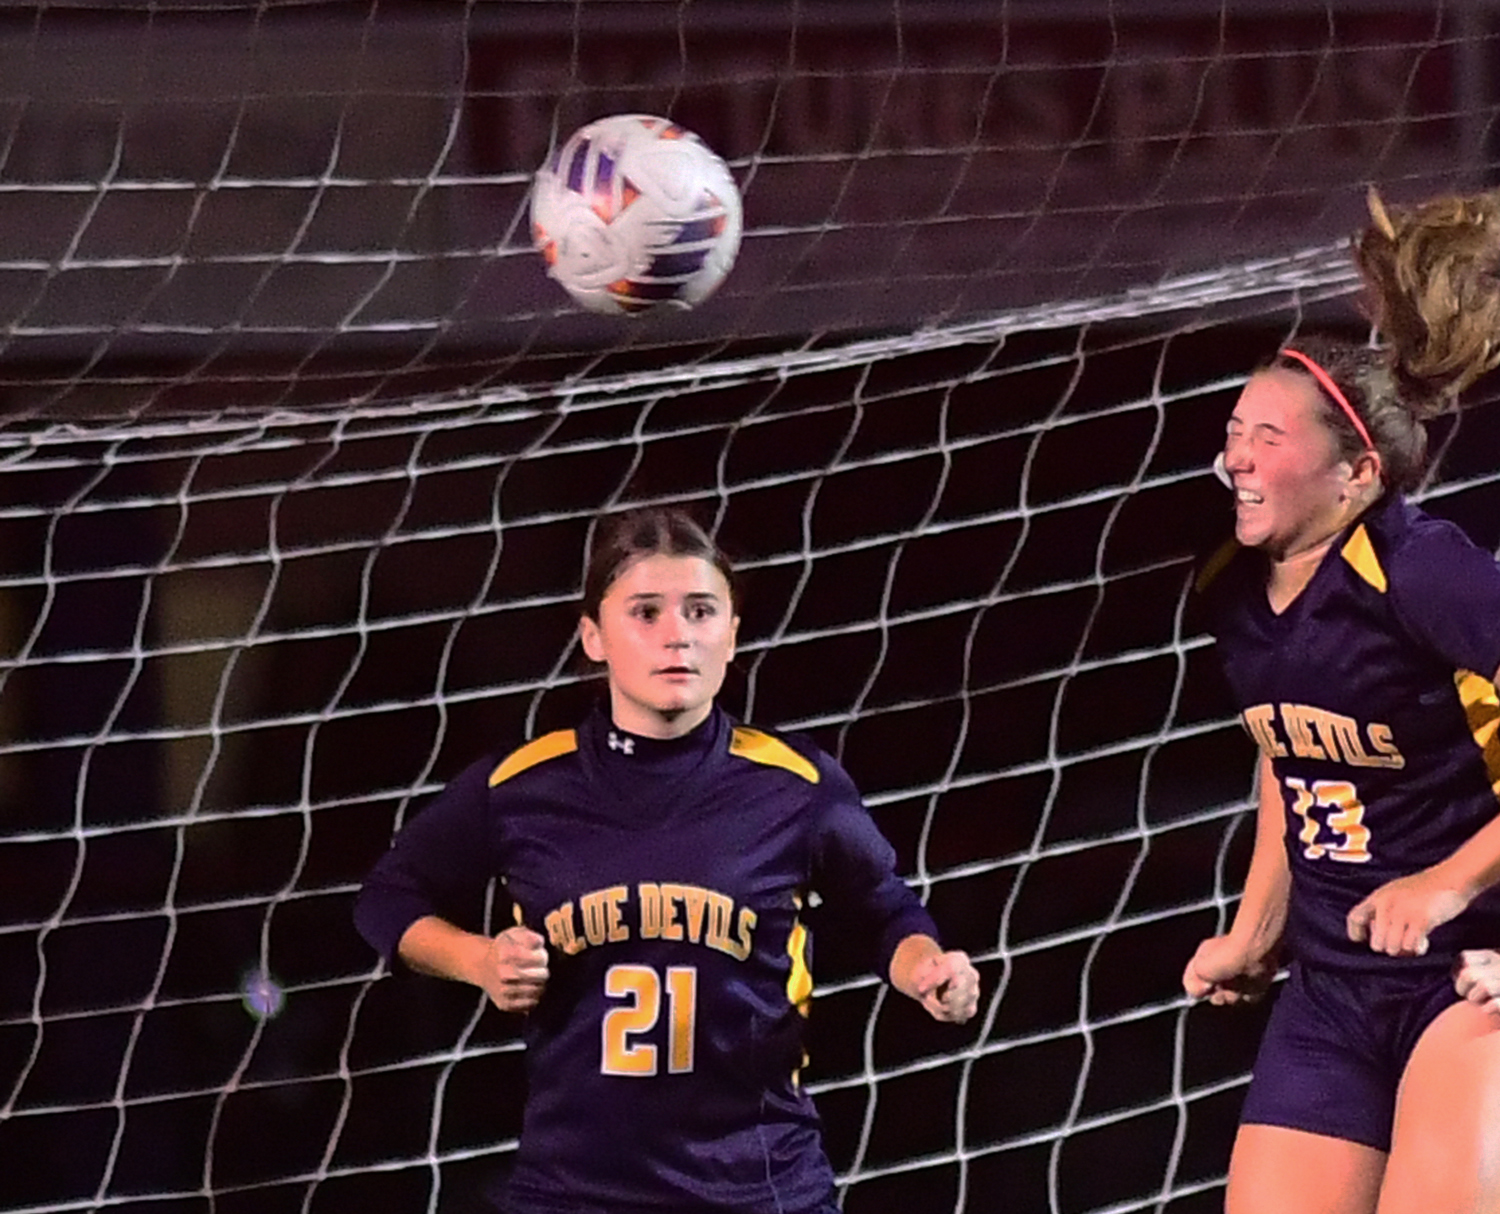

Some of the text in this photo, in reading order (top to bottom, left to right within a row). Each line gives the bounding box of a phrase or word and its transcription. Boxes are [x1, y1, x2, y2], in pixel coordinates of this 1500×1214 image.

[1285, 777, 1373, 863] 13
[544, 883, 758, 961] BLUE DEVILS
[601, 964, 697, 1076] 21
